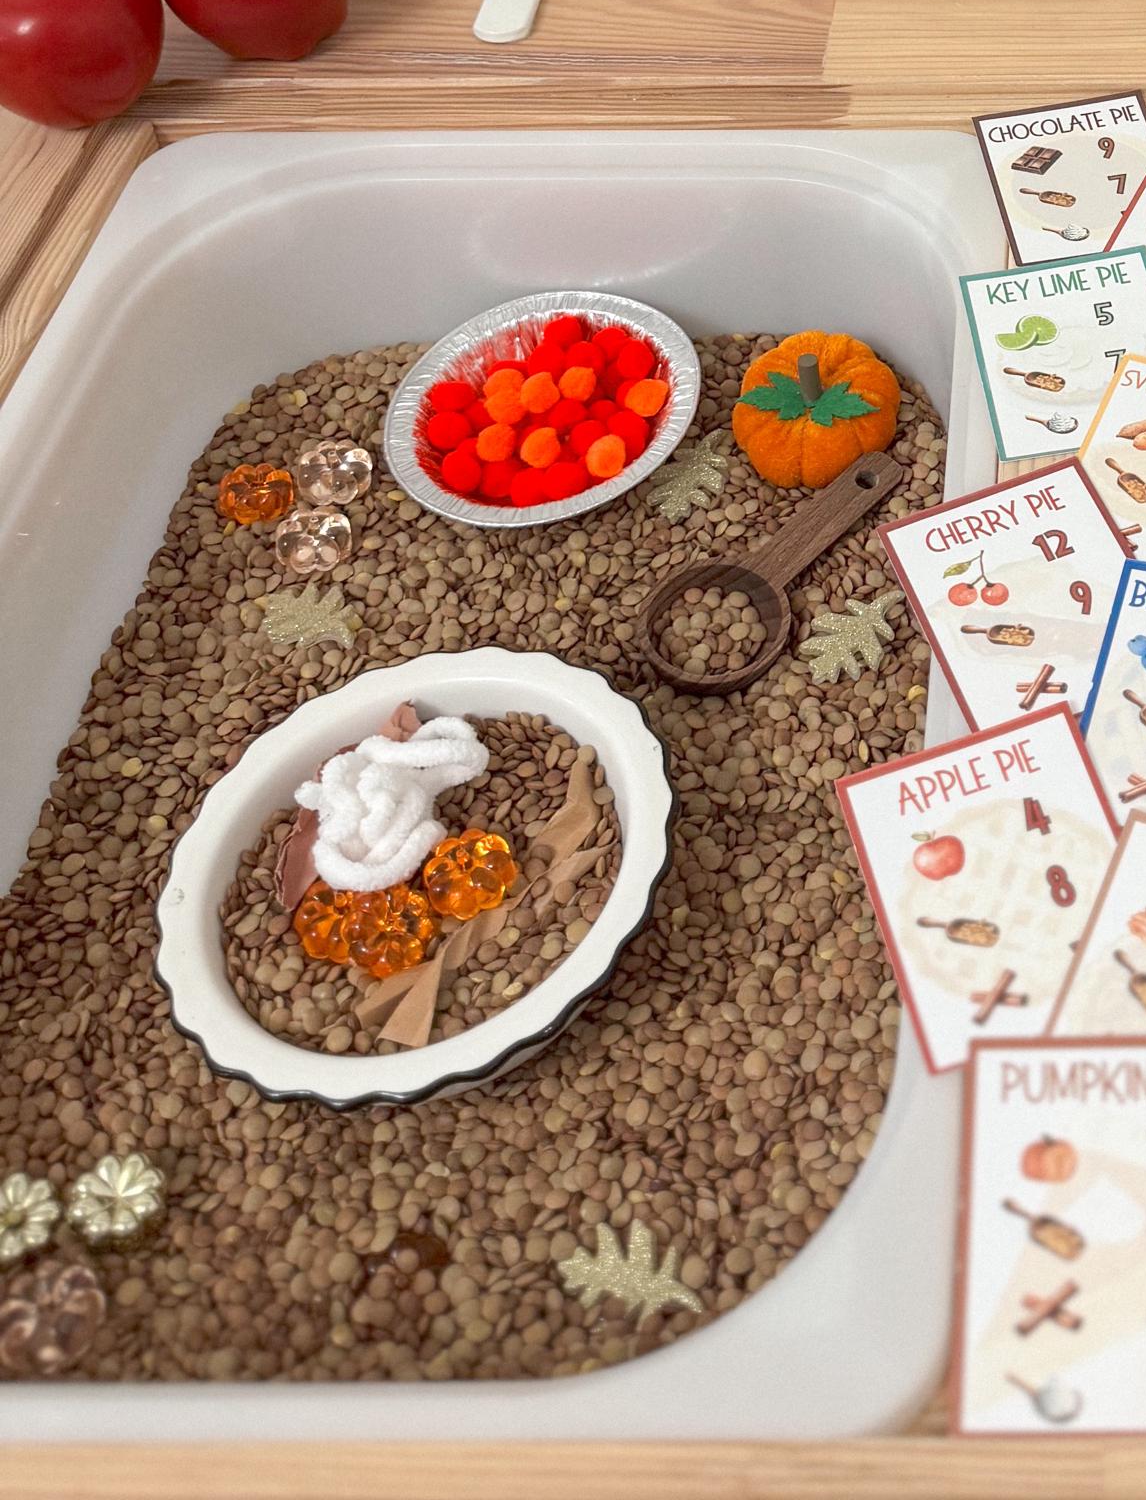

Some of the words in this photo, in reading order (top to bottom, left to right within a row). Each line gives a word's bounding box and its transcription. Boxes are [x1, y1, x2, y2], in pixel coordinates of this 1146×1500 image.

[988, 112, 1105, 143] CHOCOLATE
[1109, 104, 1140, 126] PIE
[1097, 136, 1115, 159] 9
[1107, 173, 1127, 194] 7
[986, 278, 1030, 305] KEY
[1038, 269, 1091, 298] LIME
[1099, 261, 1131, 288] PIE
[1093, 301, 1115, 326] 5
[925, 500, 1021, 554] CHERRY
[1024, 485, 1066, 520] PIE
[1032, 529, 1075, 562] 12
[1069, 580, 1092, 615] 9
[899, 758, 990, 815] APPLE
[999, 739, 1041, 777] PIE
[1023, 797, 1050, 835] 4
[1045, 865, 1077, 908] 8
